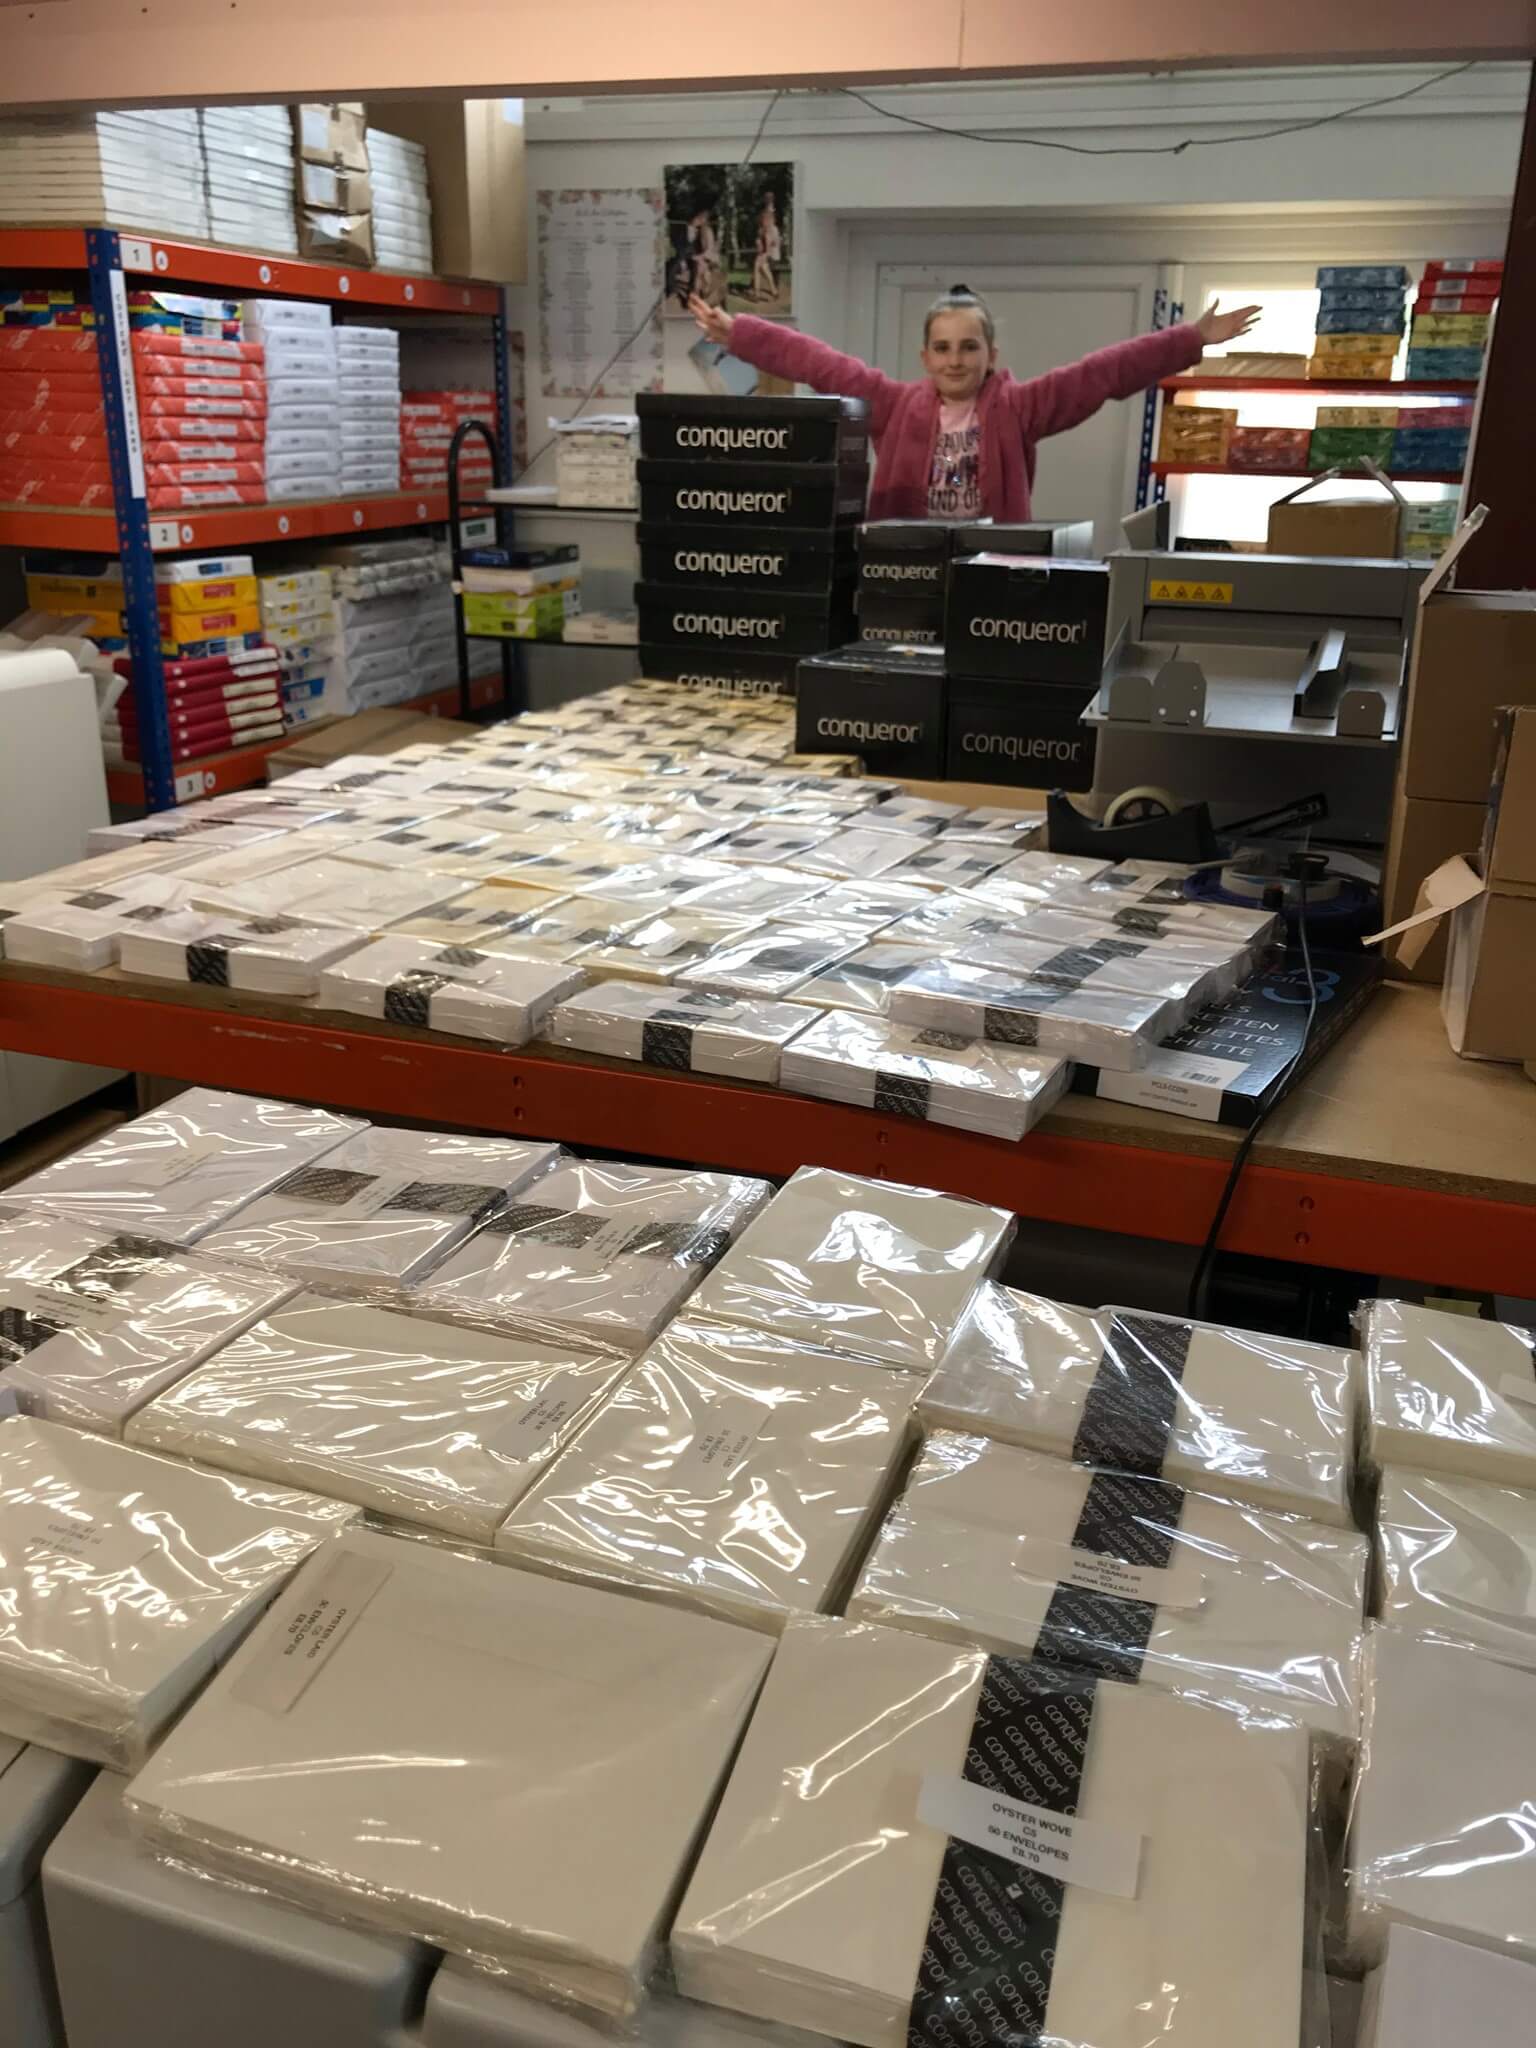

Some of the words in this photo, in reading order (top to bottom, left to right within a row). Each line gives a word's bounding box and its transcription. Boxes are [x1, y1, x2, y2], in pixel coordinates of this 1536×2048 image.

[675, 425, 789, 452] conqueror
[675, 488, 786, 515] conqueror
[674, 551, 784, 577] conqueror
[862, 564, 940, 581] conqueror
[672, 613, 781, 639] conqueror
[969, 616, 1081, 644] conqueror
[817, 717, 919, 743] conqueror
[962, 732, 1081, 761] conqueror
[992, 1803, 1036, 1824] OYSTER
[1039, 1818, 1073, 1838] WOVE
[1003, 1830, 1070, 1861] ENVELOPES
